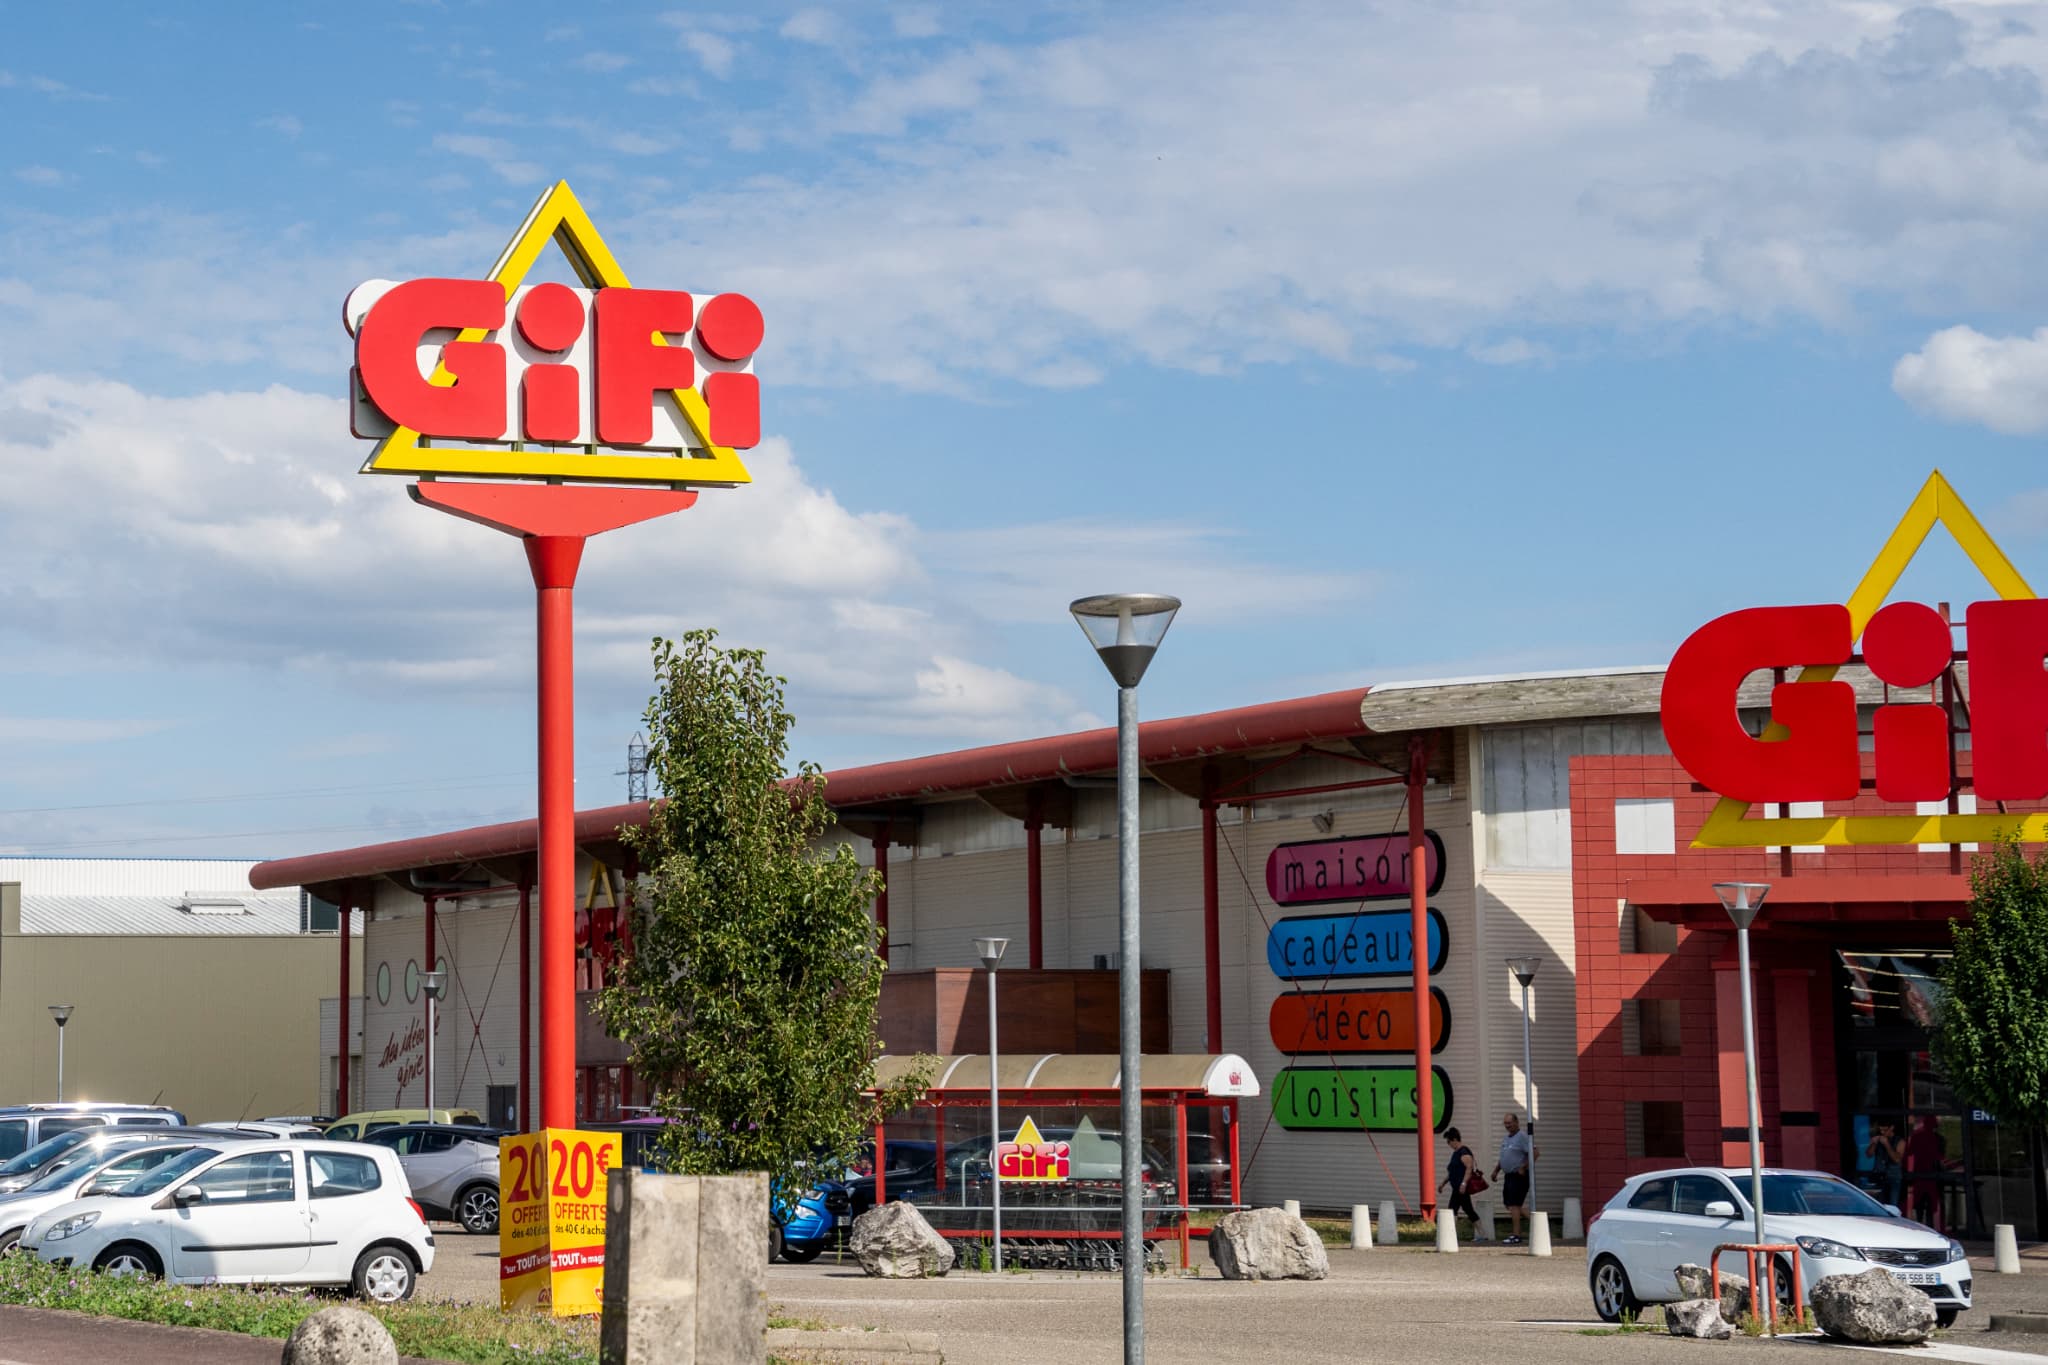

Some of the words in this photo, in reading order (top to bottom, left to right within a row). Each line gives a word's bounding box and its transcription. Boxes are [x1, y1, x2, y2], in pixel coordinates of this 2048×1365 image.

[358, 277, 764, 449] GiFi
[1315, 997, 1391, 1041] déco
[394, 1053, 424, 1109] génie
[1291, 1075, 1418, 1119] loisirs
[1972, 1109, 1996, 1121] EN
[507, 1141, 548, 1203] 20
[998, 1142, 1070, 1177] GiFi
[555, 1202, 606, 1221] OFFERTS
[516, 1254, 537, 1272] TOUT
[557, 1252, 580, 1267] TOUT
